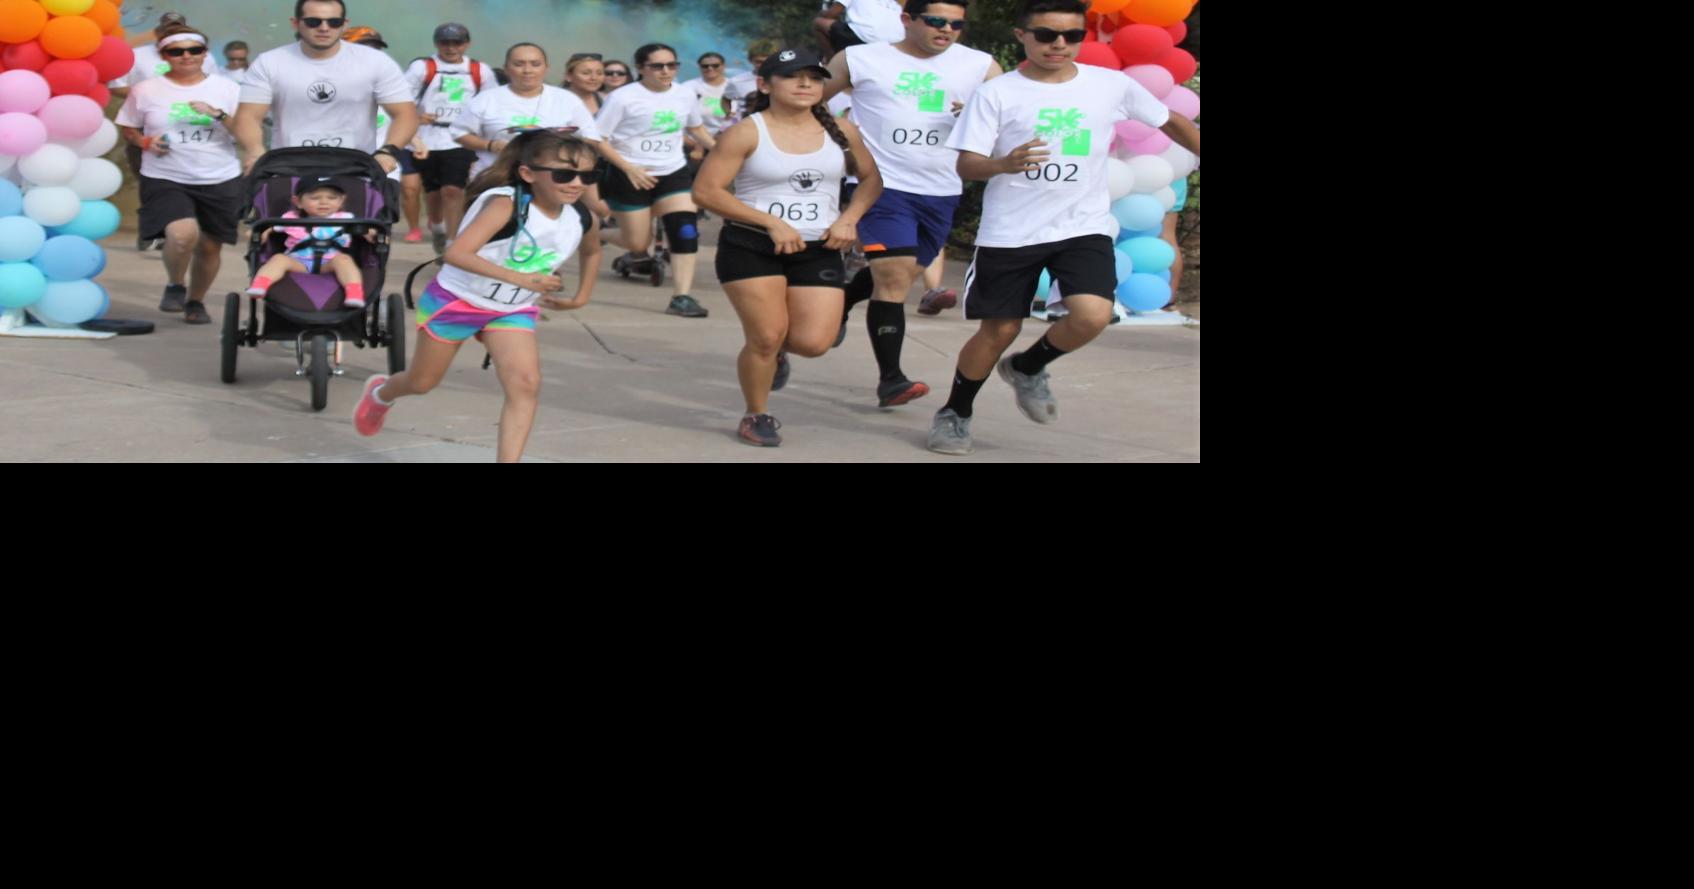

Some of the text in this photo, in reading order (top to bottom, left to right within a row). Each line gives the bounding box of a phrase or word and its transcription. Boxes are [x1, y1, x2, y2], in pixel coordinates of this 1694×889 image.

[178, 127, 214, 144] 147
[893, 128, 940, 146] 026
[640, 139, 672, 152] 025
[1025, 162, 1079, 182] 002
[768, 202, 818, 221] 063
